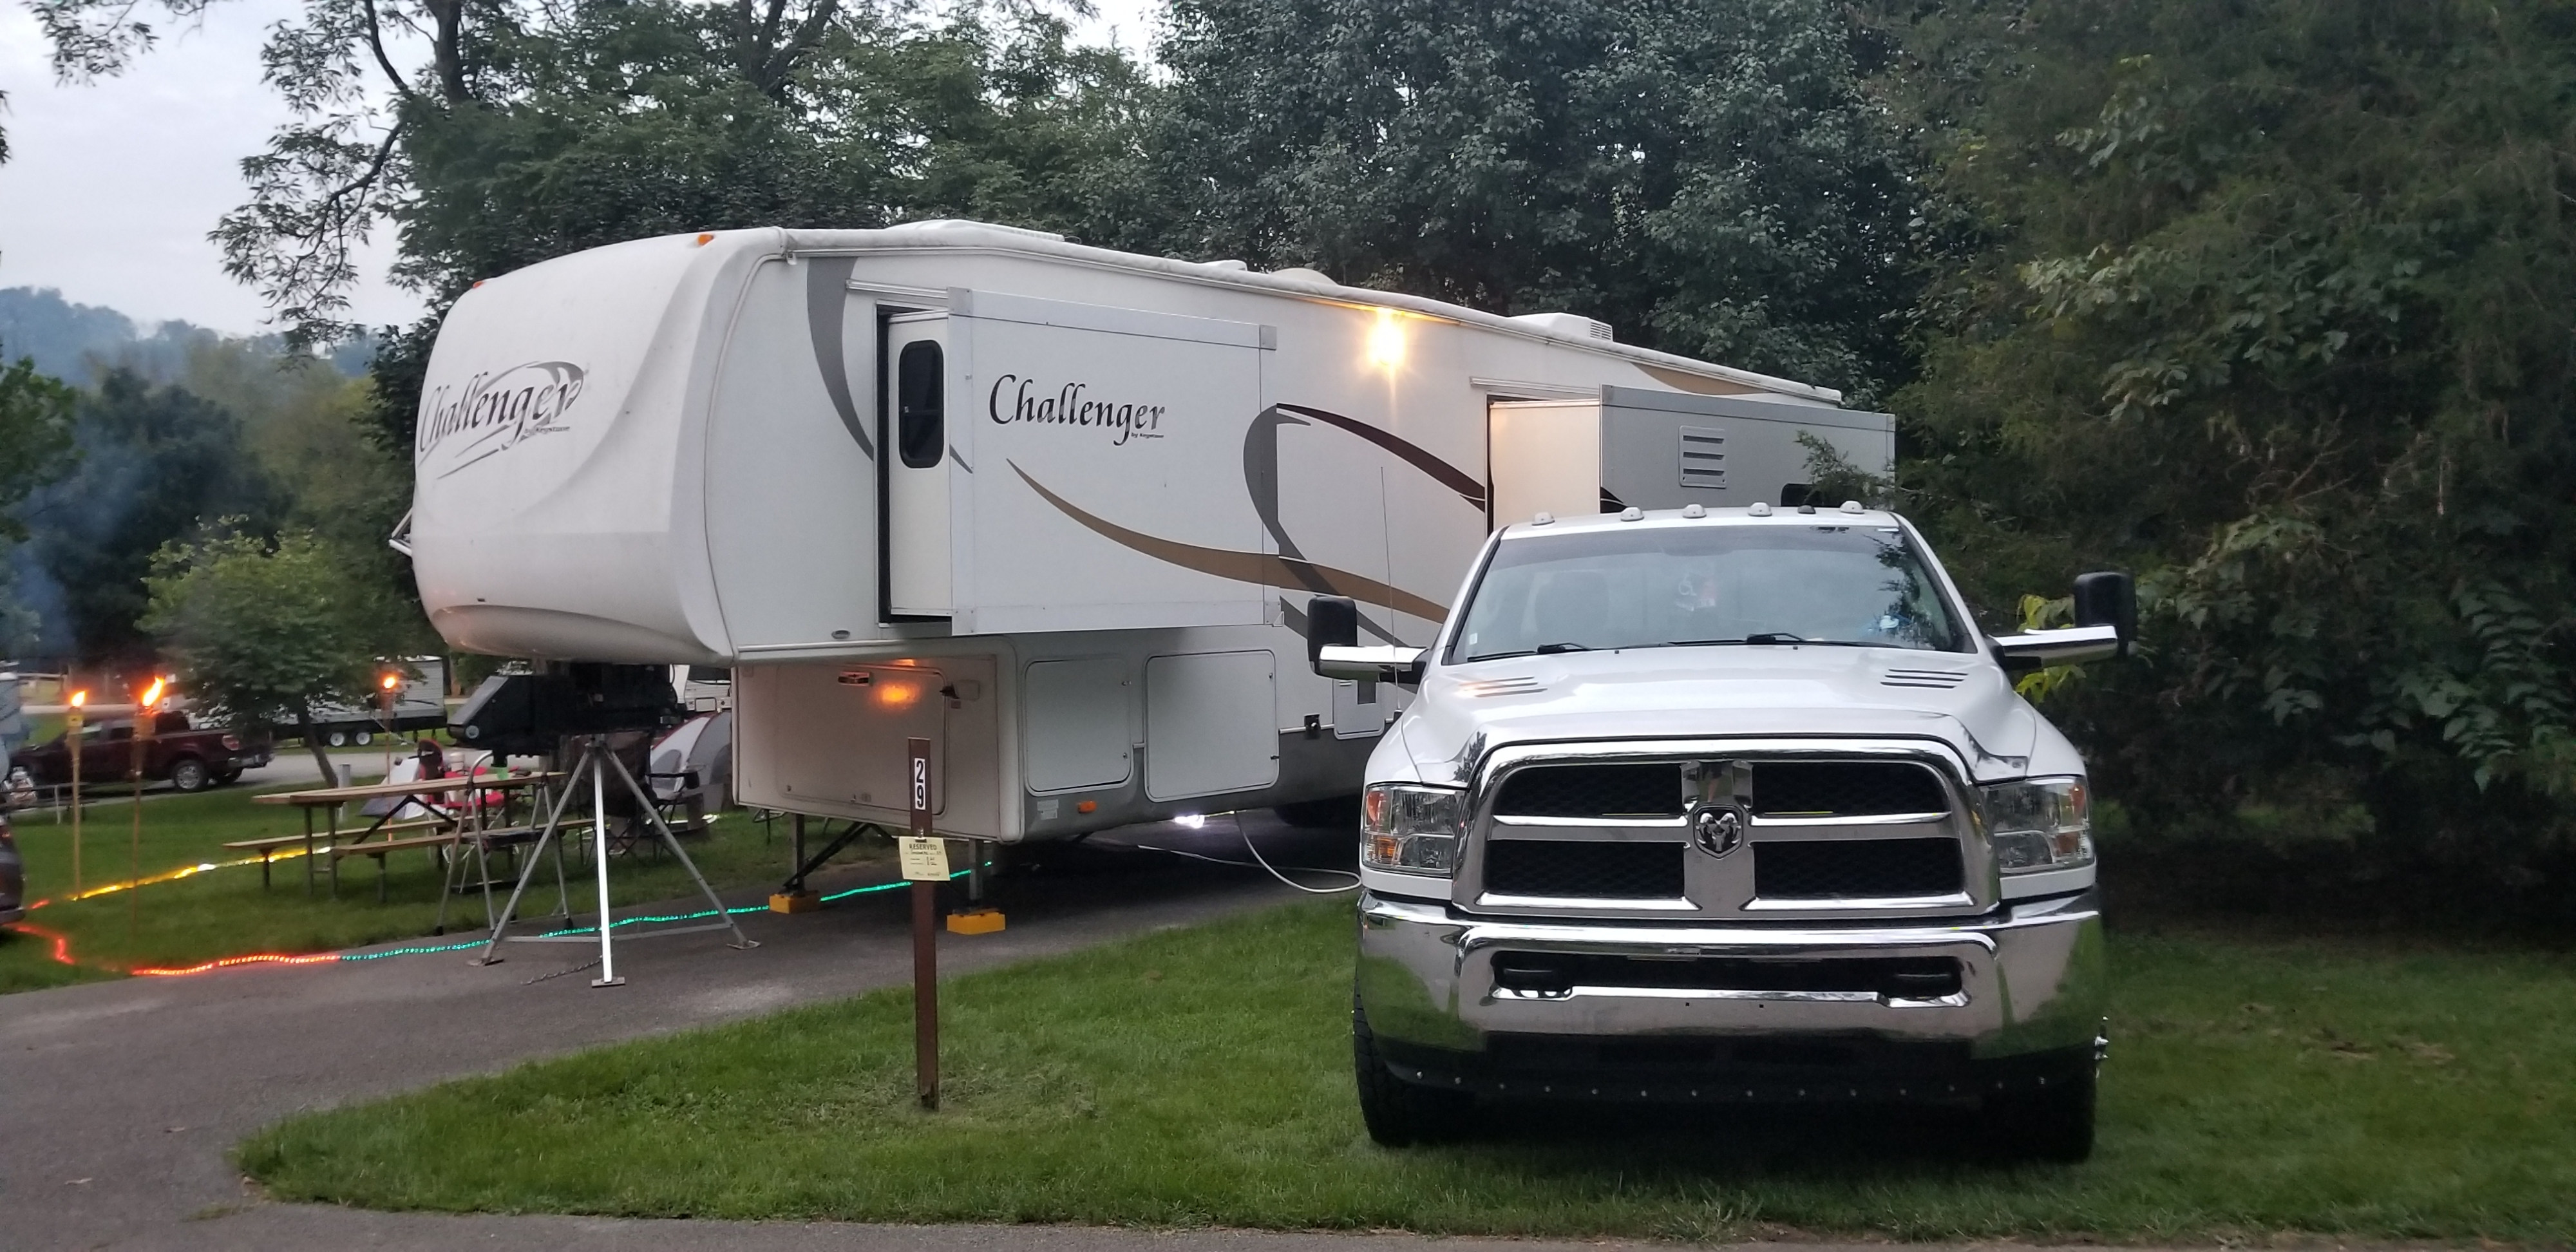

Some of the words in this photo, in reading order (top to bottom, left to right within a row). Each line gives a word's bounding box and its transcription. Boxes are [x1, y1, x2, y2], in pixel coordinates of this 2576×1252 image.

[420, 371, 582, 451] Challenger
[989, 374, 1165, 446] Challenger
[916, 760, 925, 808] 29
